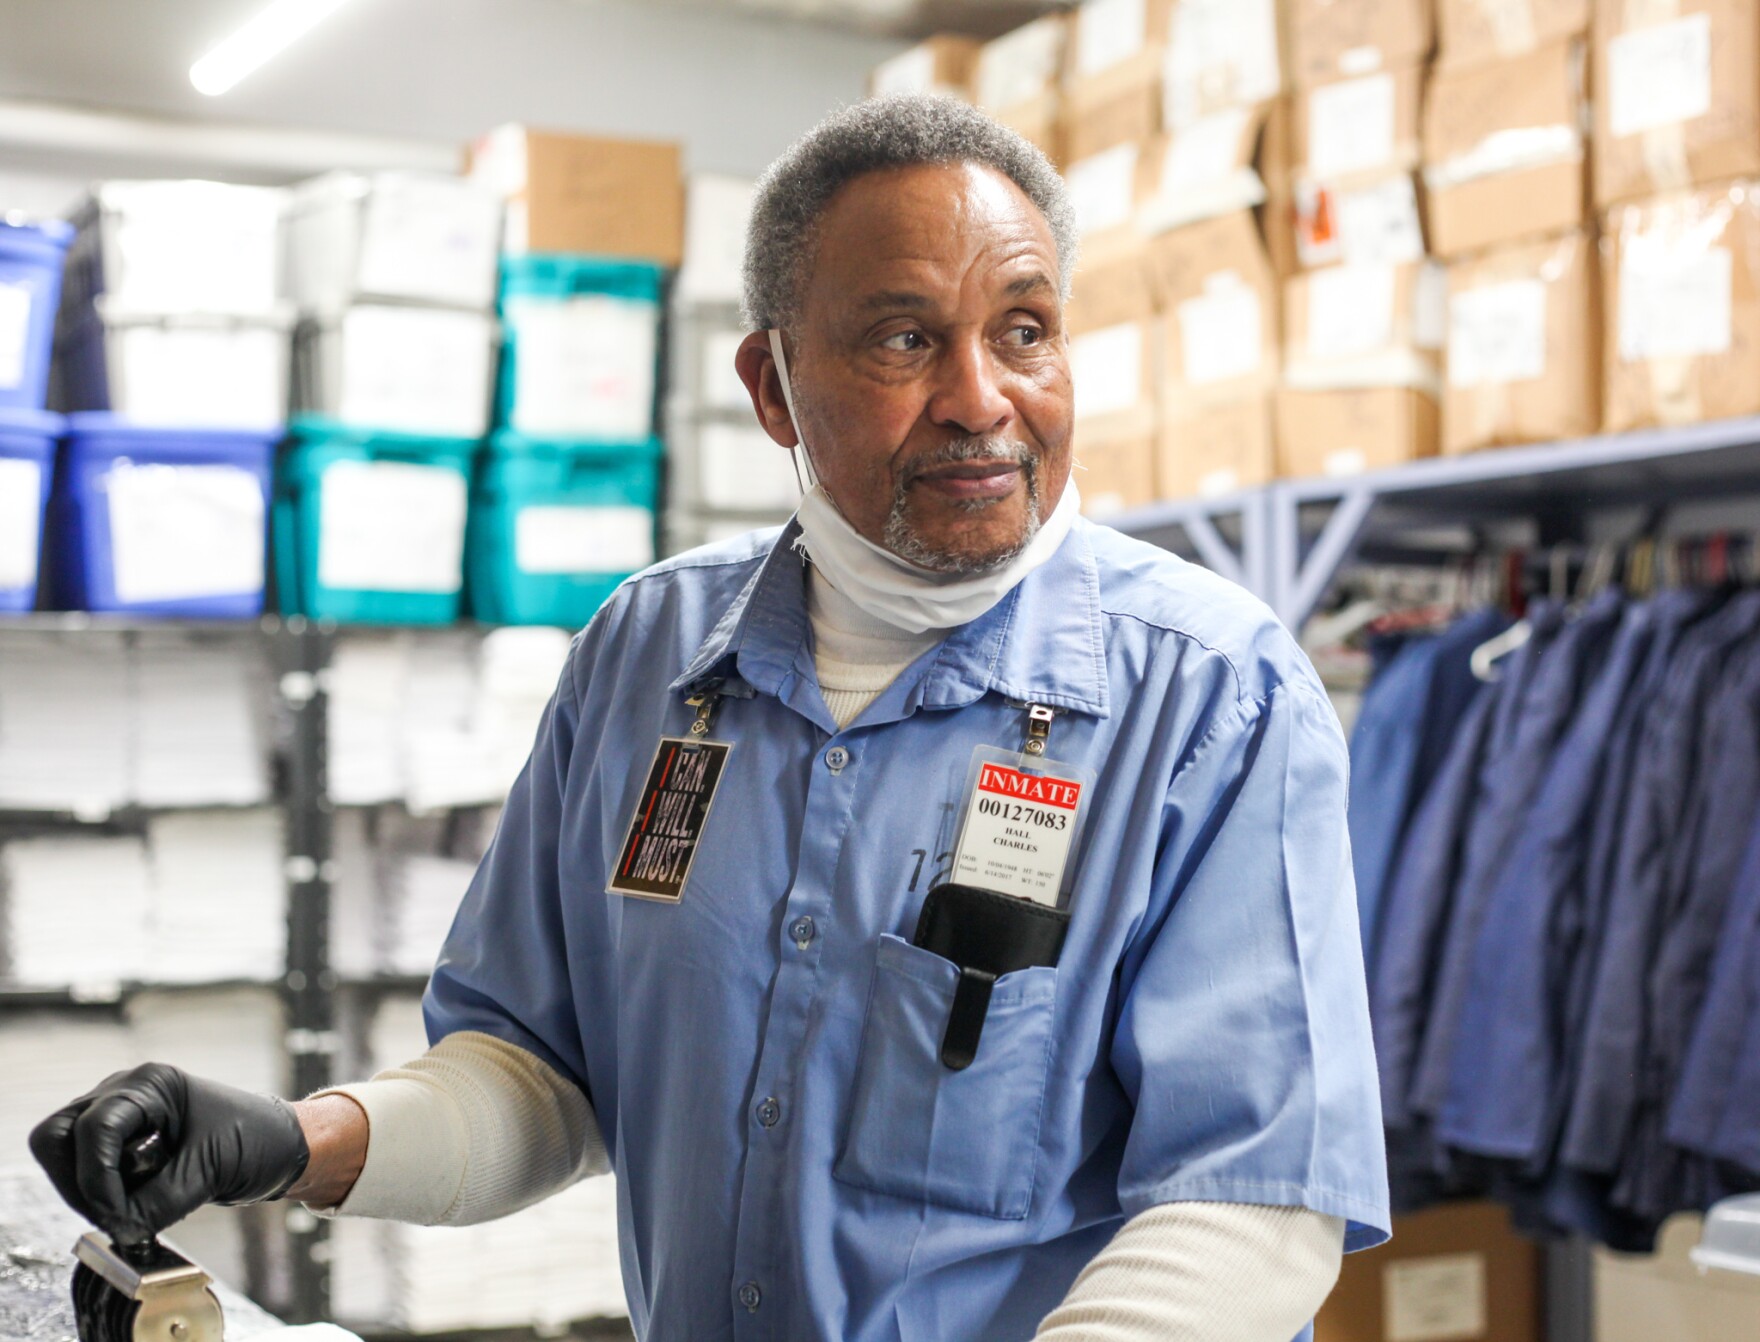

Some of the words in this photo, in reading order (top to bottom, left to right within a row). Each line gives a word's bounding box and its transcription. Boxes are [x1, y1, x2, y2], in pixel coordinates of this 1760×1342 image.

[980, 768, 1078, 806] INMATE
[978, 797, 1067, 831] 00127083
[993, 837, 1039, 853] CHARLES
[1005, 827, 1032, 840] HALL
